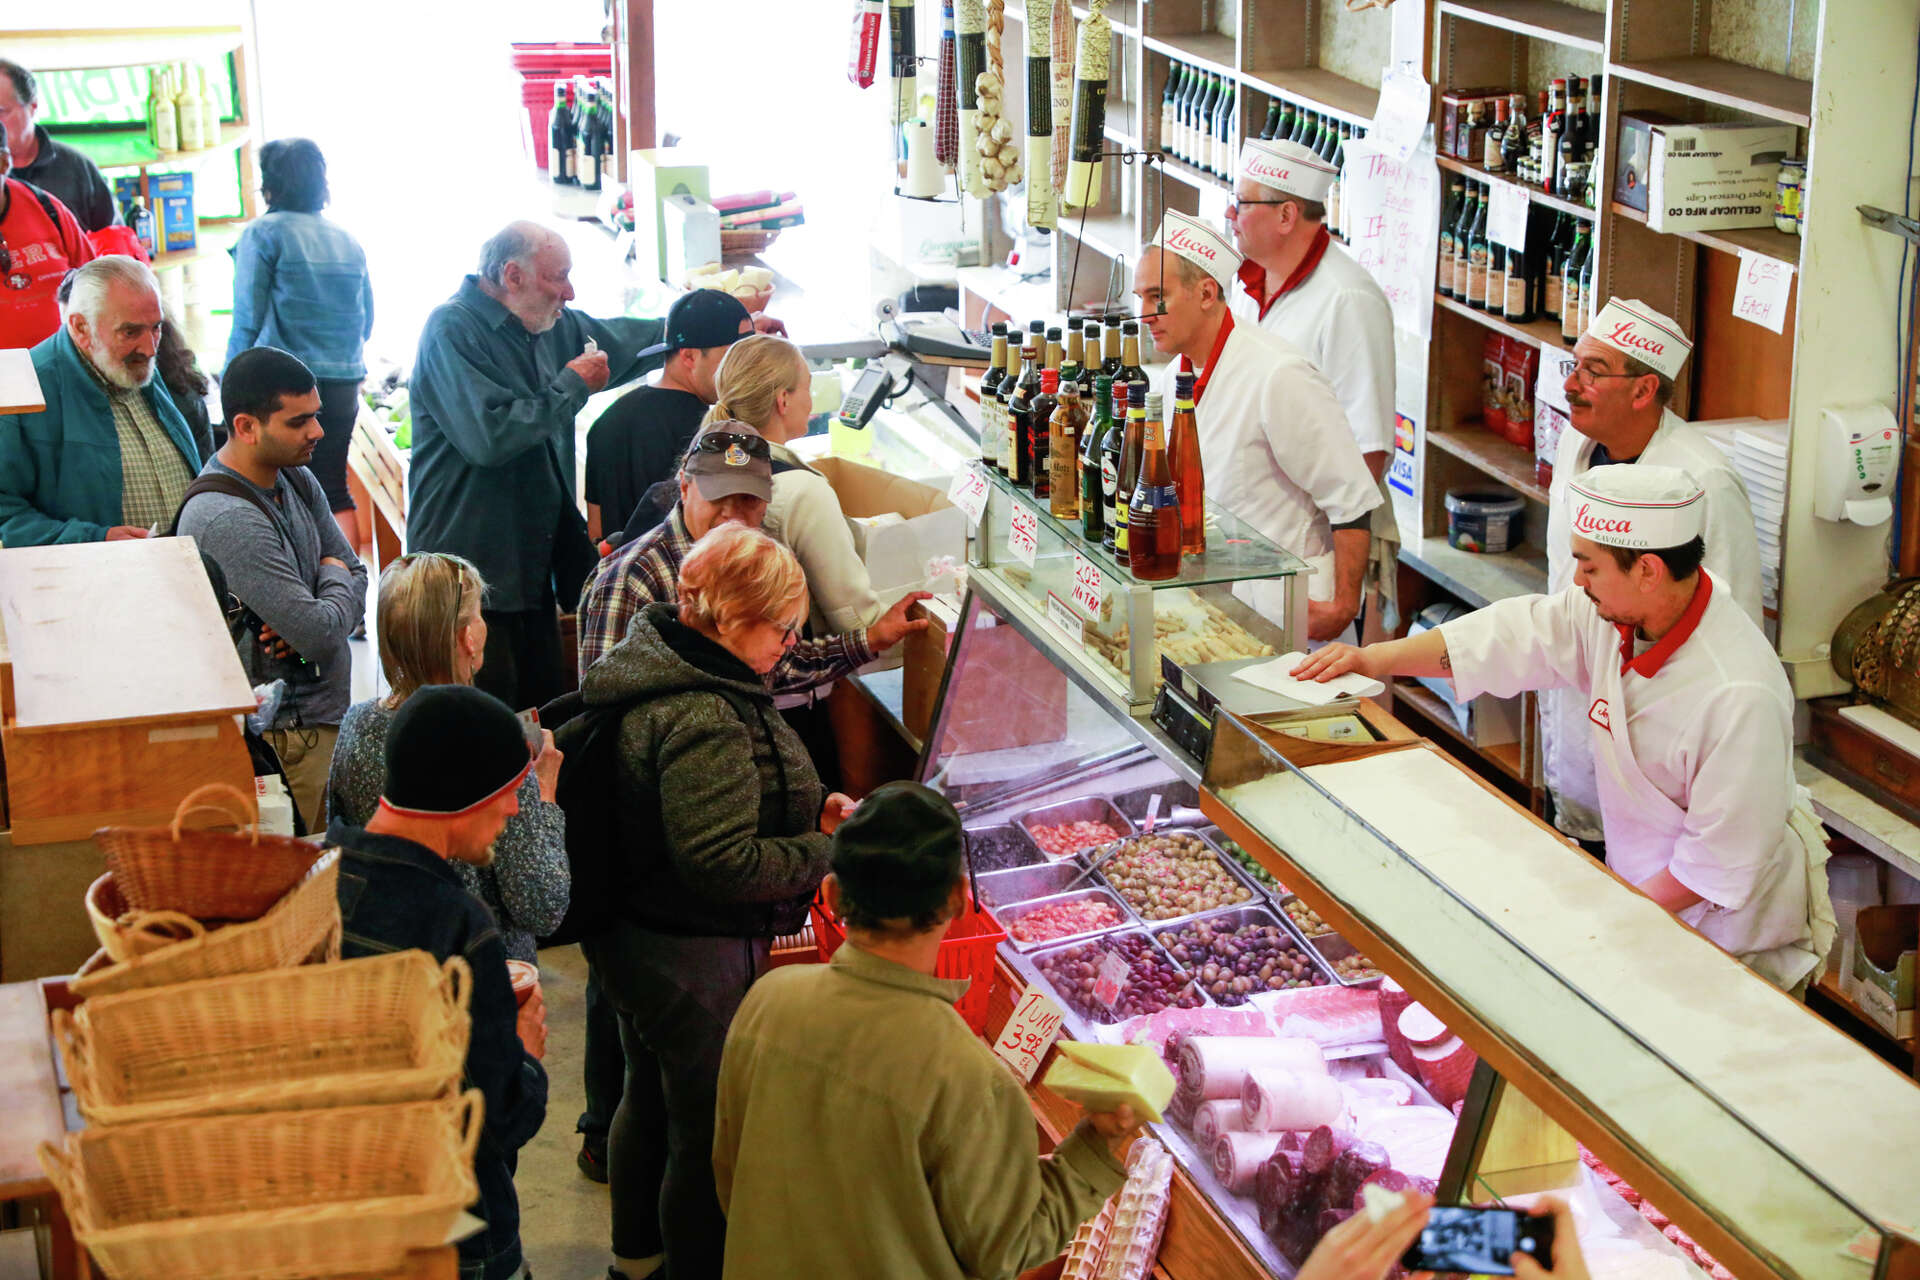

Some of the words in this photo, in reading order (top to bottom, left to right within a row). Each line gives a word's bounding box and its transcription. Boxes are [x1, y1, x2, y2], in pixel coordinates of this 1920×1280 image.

[1245, 154, 1289, 179] Lucca
[1668, 208, 1683, 216] CO
[1686, 207, 1707, 216] MFG
[1710, 205, 1761, 215] CELLUCAP
[1165, 227, 1216, 260] Lucca
[1740, 295, 1773, 320] EACH
[1601, 321, 1664, 356] Lucca
[1393, 459, 1413, 481] VISA
[1573, 503, 1632, 533] Lucca
[1084, 592, 1099, 616] TAX
[1018, 993, 1061, 1038] TUNA
